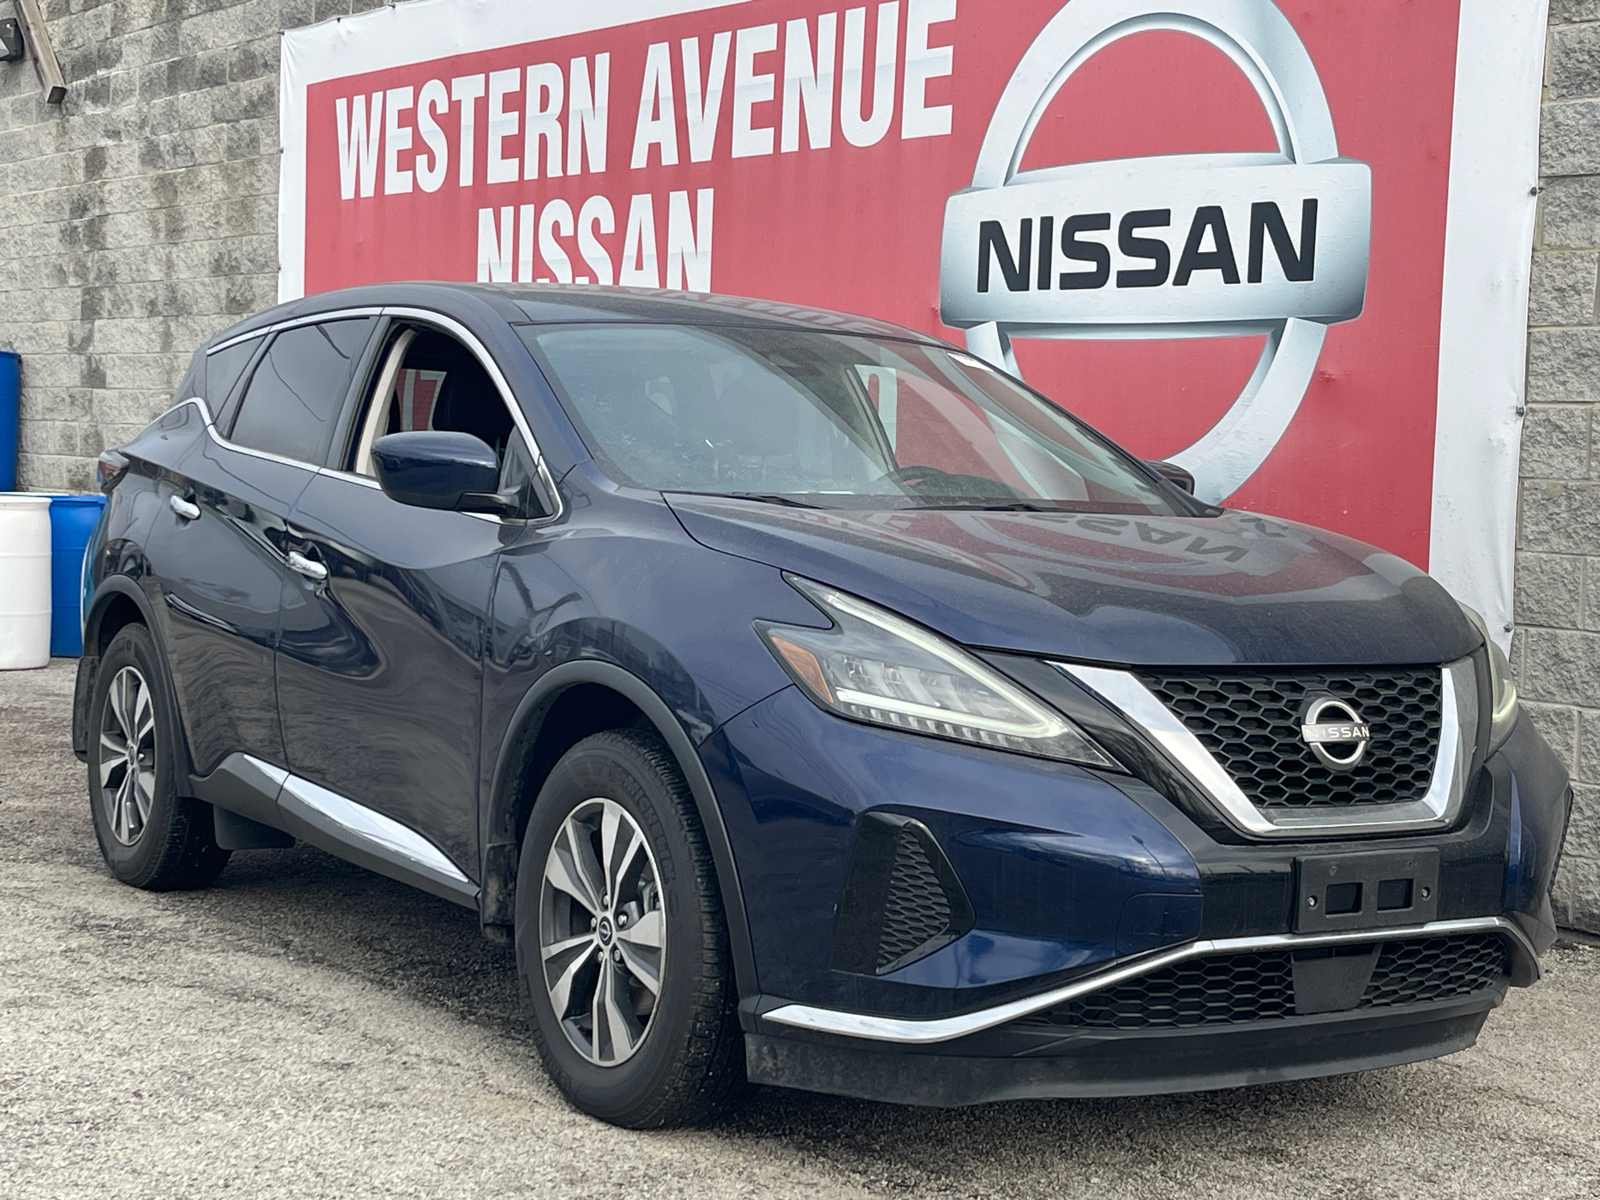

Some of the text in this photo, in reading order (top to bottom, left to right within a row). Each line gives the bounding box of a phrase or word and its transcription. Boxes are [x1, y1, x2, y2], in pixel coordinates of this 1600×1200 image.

[336, 0, 957, 200] WESTERN AVENUE
[477, 188, 714, 293] NISSAN
[977, 198, 1318, 293] NISSAN
[1305, 726, 1370, 738] NISSAN
[622, 774, 677, 882] MICHELIN
